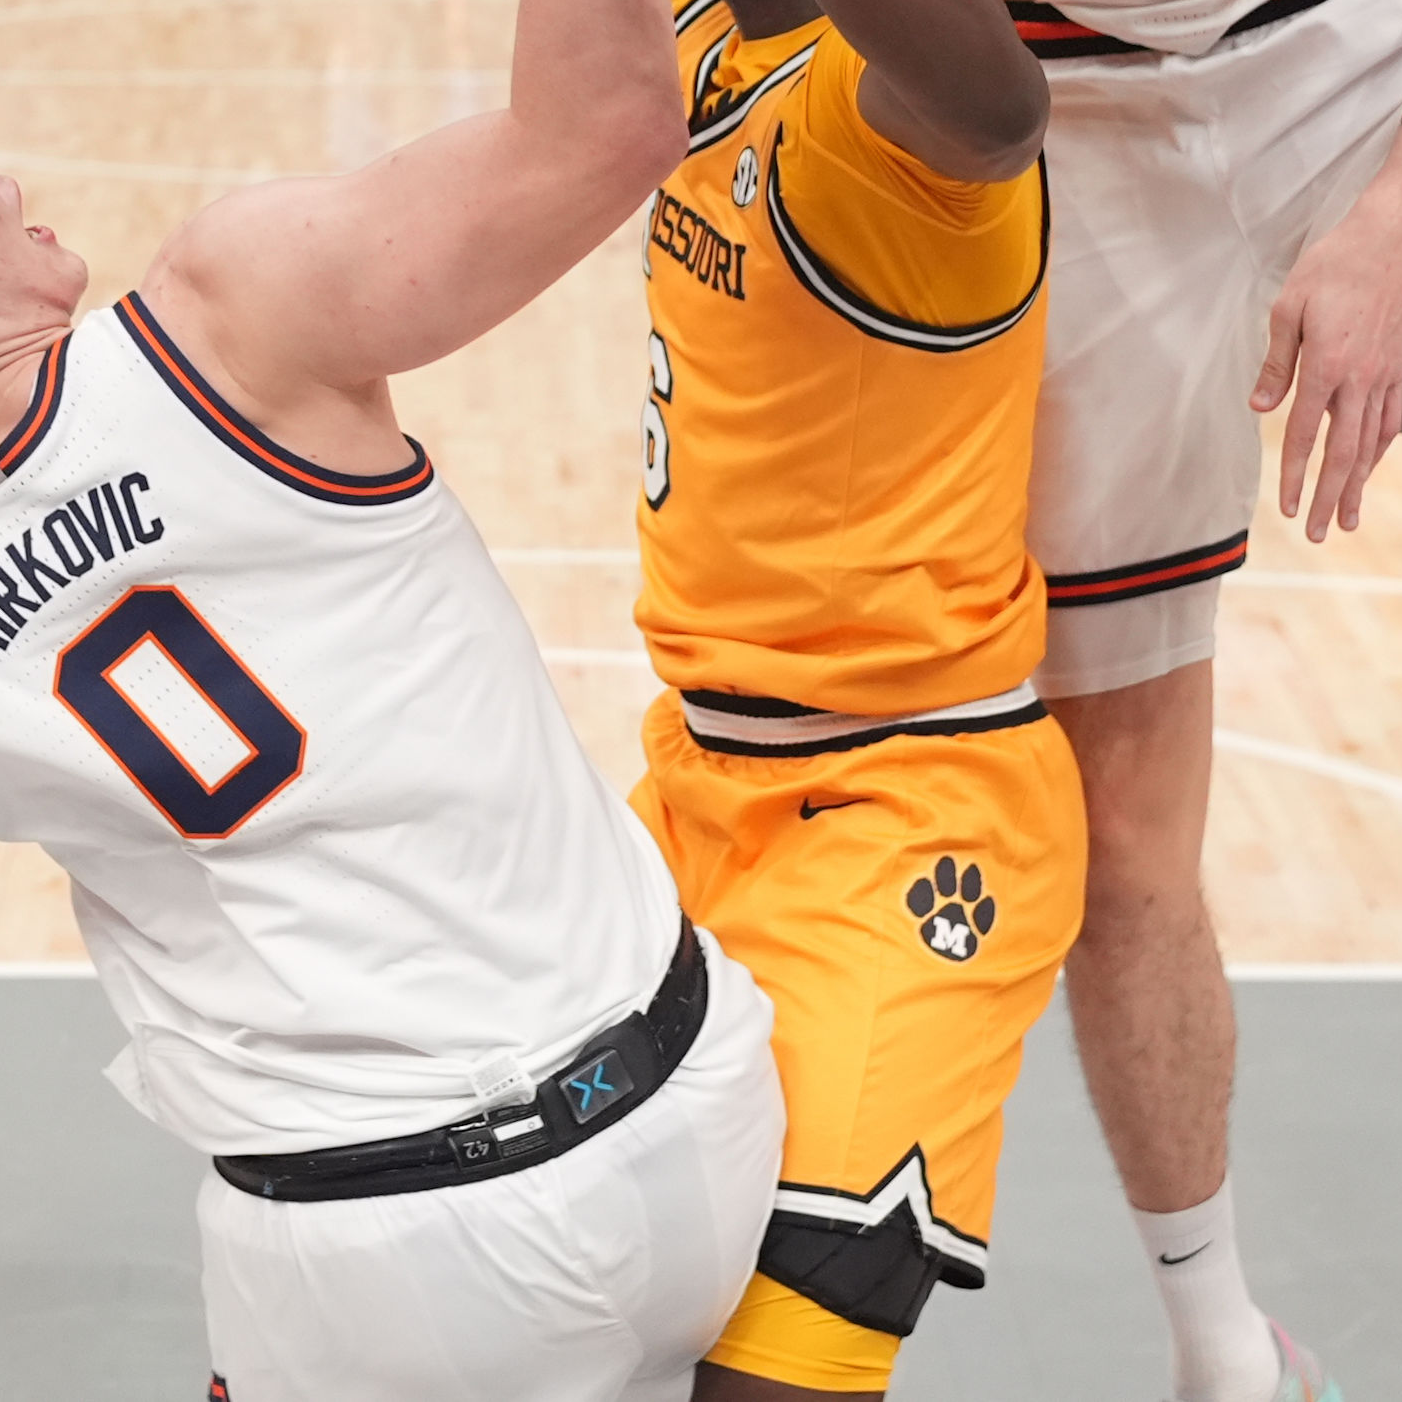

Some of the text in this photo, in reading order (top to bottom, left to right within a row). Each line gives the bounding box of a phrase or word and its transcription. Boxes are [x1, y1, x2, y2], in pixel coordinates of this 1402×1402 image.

[650, 188, 747, 301] ISSOURI
[53, 584, 308, 840] 0
[930, 916, 971, 958] M
